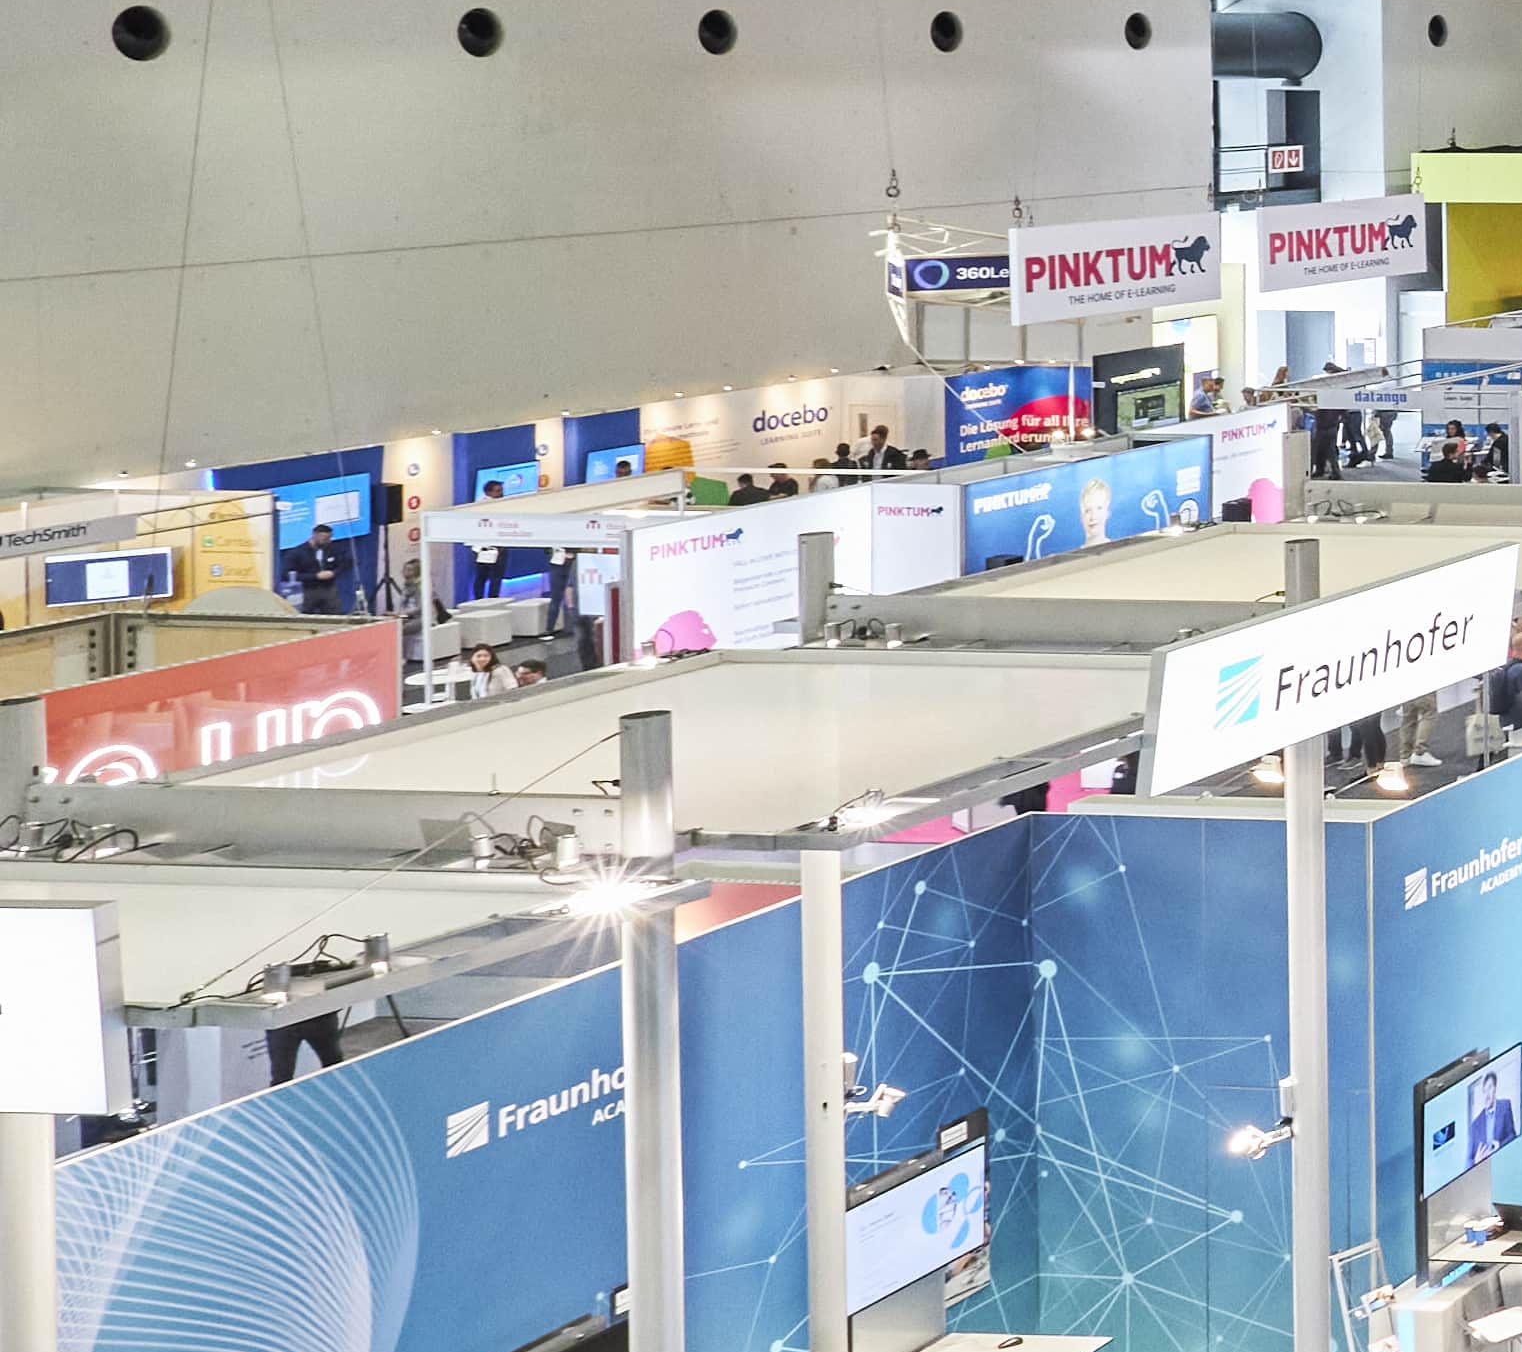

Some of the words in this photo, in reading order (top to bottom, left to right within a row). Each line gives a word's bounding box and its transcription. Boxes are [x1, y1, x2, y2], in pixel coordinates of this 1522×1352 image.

[1269, 221, 1387, 264] PINKTUM
[1025, 244, 1173, 294] PINKTUM
[1069, 295, 1087, 306] THE
[1089, 292, 1112, 305] HOME
[960, 384, 1007, 402] docebo
[1354, 390, 1408, 406] datango
[753, 404, 828, 434] docebo
[960, 422, 977, 436] Die
[979, 418, 1019, 434] Lösung
[1021, 414, 1041, 427] für
[1043, 414, 1060, 426] all
[878, 506, 930, 517] PINKTUM
[6, 525, 88, 548] TechSmith
[1275, 612, 1474, 711] Fraunhofer
